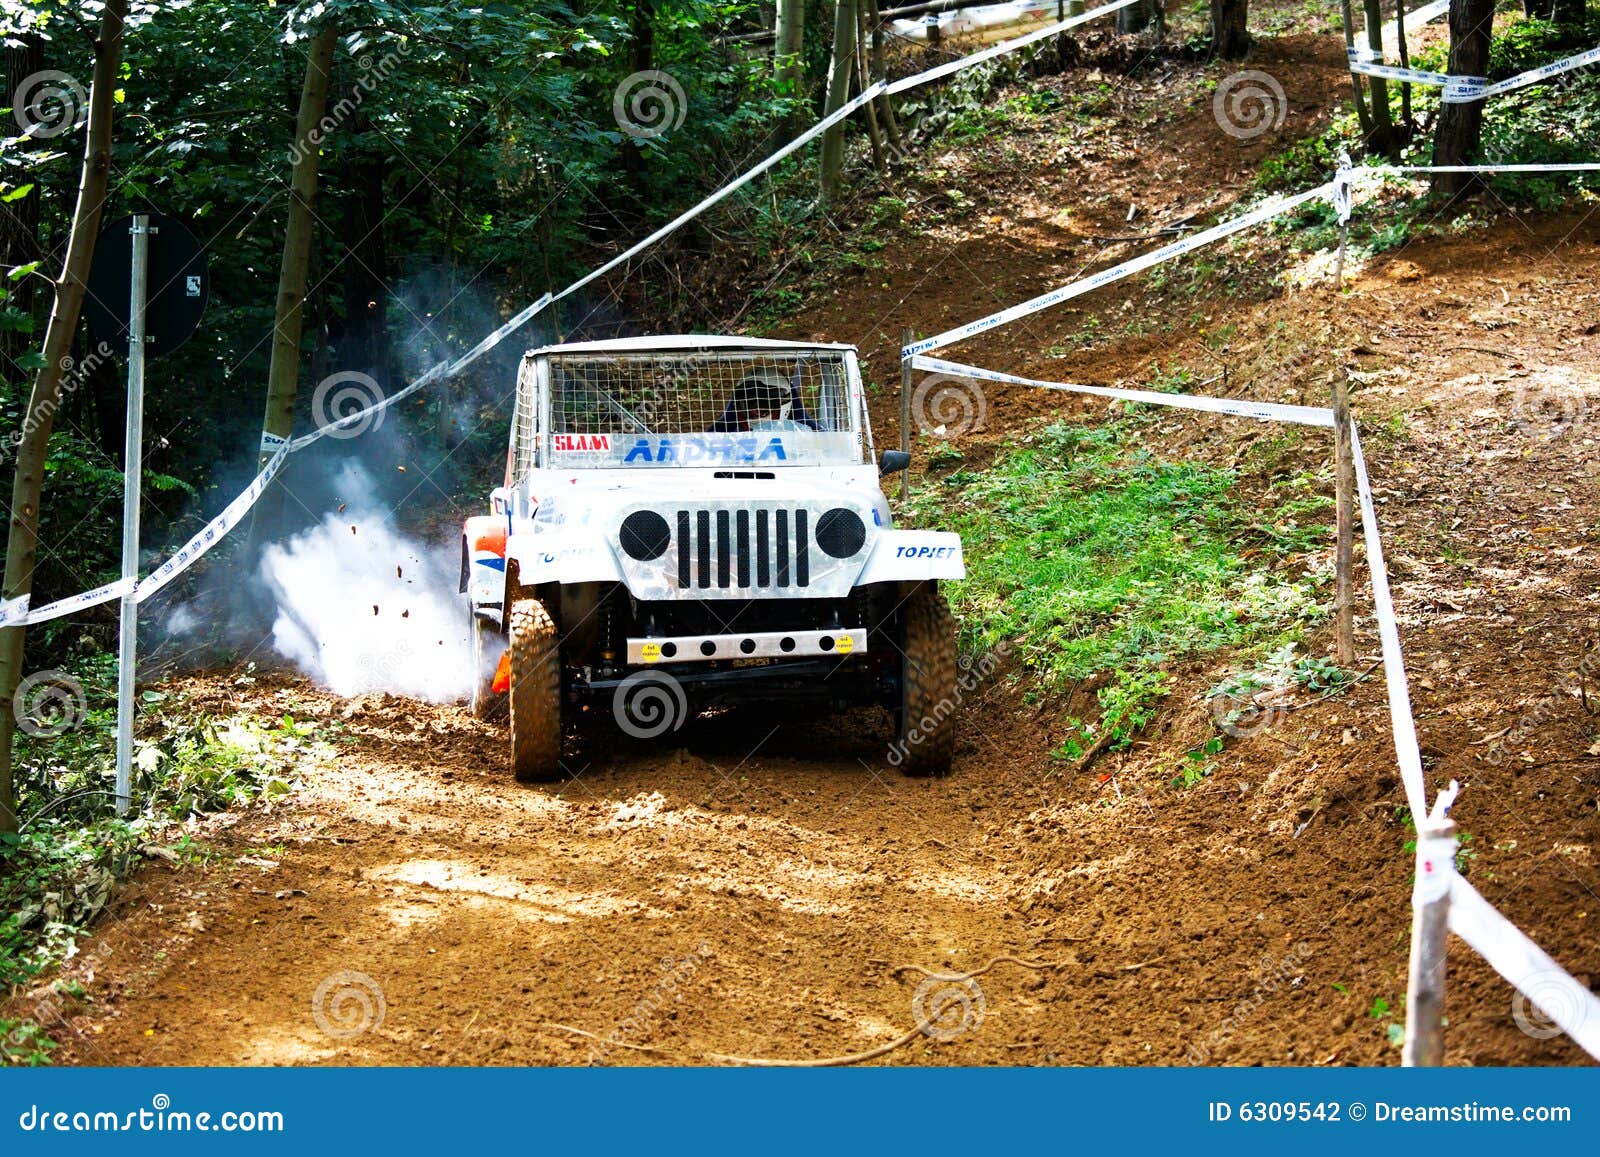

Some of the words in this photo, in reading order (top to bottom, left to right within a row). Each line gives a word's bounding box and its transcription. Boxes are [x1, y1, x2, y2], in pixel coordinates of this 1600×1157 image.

[901, 340, 938, 358] SUZUKI
[555, 435, 610, 451] SLAM
[896, 546, 956, 558] TOPJET
